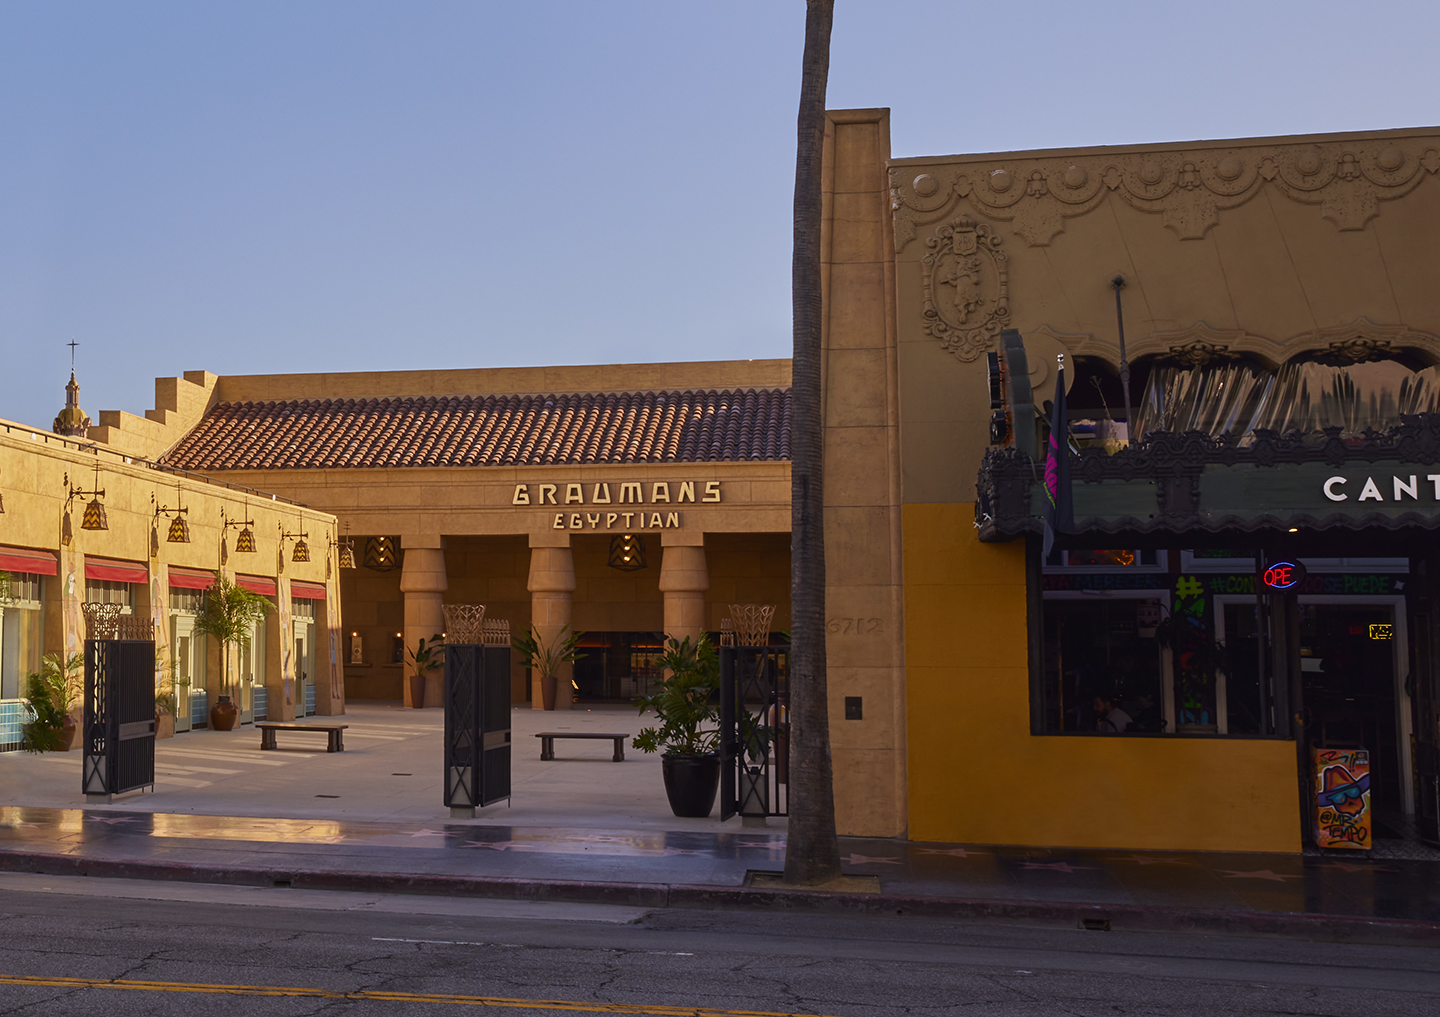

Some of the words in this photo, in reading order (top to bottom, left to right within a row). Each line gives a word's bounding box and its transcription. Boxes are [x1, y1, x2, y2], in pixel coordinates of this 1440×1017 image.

[511, 481, 722, 505] GRAUMANS
[1323, 474, 1440, 502] CANT
[552, 512, 680, 529] EGYPTIAN
[826, 617, 884, 635] 6712
[1323, 825, 1368, 843] TEMPO
